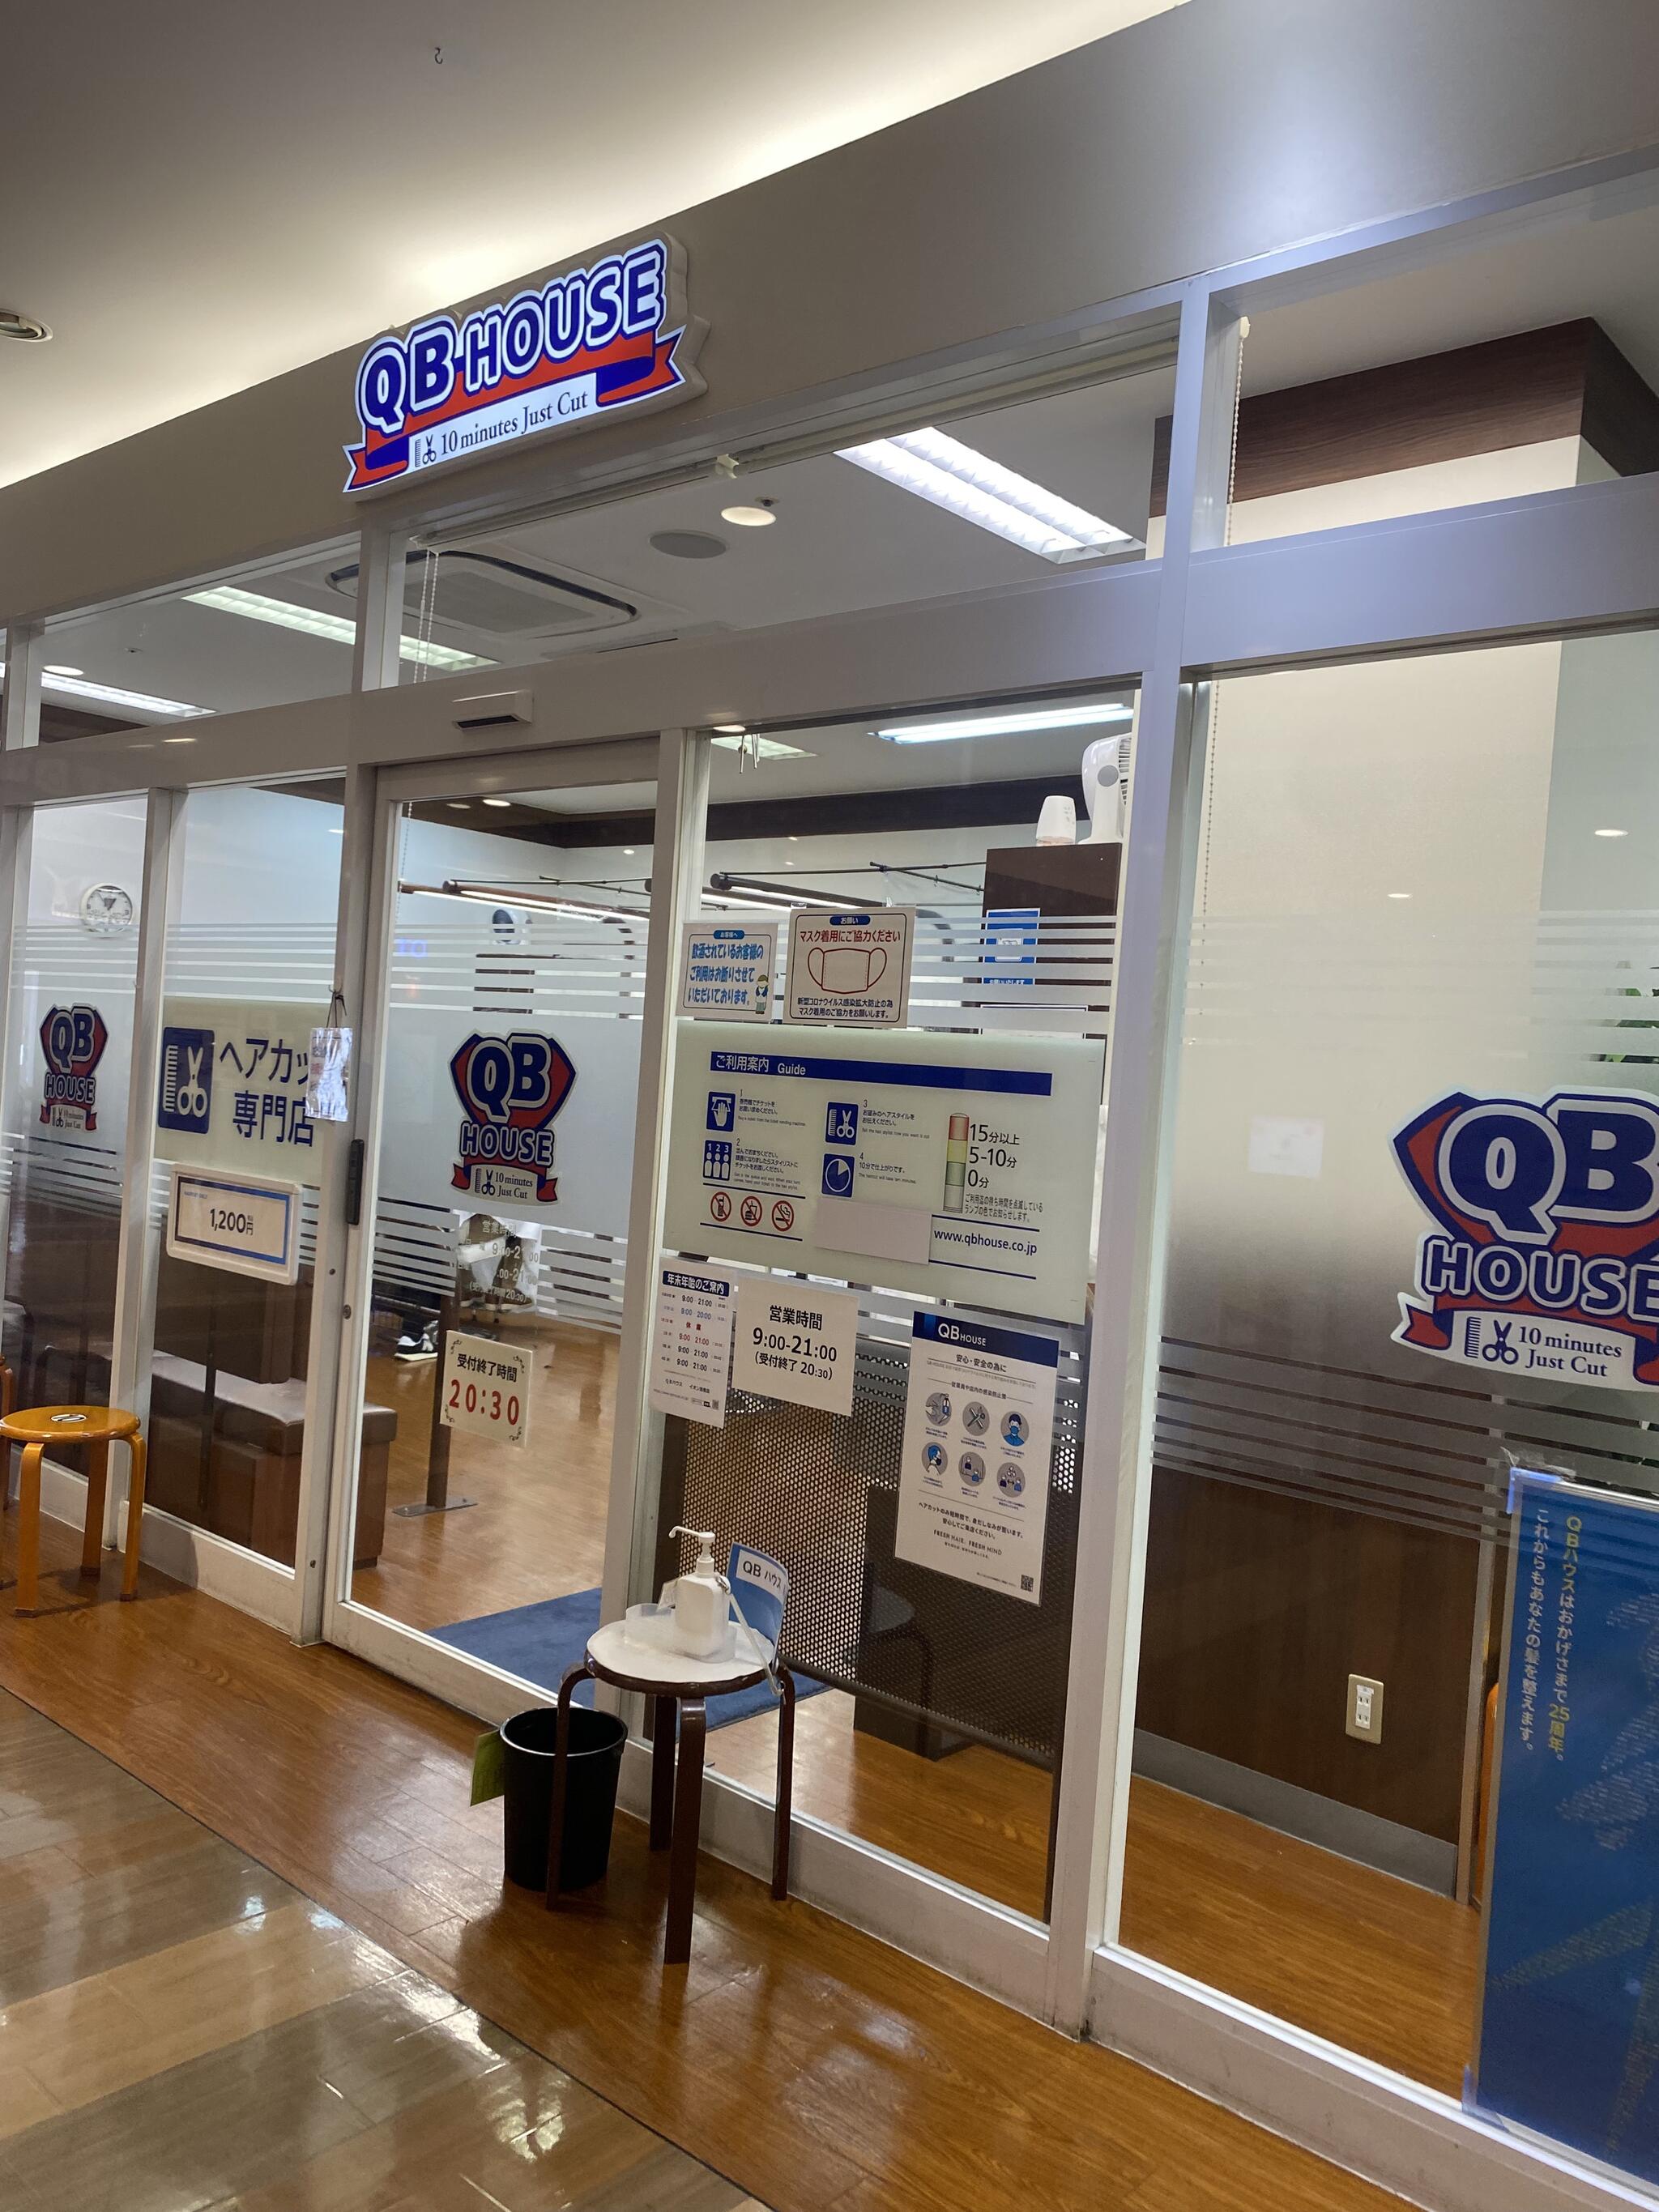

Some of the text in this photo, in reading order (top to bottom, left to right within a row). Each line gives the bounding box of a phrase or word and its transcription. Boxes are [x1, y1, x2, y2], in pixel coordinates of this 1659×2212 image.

[363, 249, 659, 428] QB HOUSE
[441, 391, 588, 456] 10 minutes Just Cut
[840, 916, 859, 925] お願い
[800, 929, 901, 943] マスク着用にご協力ください
[692, 943, 764, 961] 飲酒されているお客様の
[689, 965, 755, 982] ご利用はお断りさせて
[688, 987, 750, 1005] いただいております。
[799, 1008, 889, 1019] マスク着用のご協力をお願いします。
[49, 1009, 94, 1072] QB
[220, 1038, 311, 1085] ヘアカッ
[715, 1055, 806, 1076] ご利用案内 Guide
[45, 1074, 96, 1103] HOUSE
[468, 1040, 550, 1119] QB
[863, 1099, 868, 1108] 3
[232, 1089, 315, 1148] 専門店
[461, 1123, 554, 1166] HOUSE
[736, 1138, 740, 1147] 2
[970, 1123, 1020, 1145] 15分以上
[707, 1143, 729, 1153] 1 2 3
[859, 1152, 864, 1161] 4
[969, 1146, 1017, 1168] 5-10分
[495, 1171, 533, 1187] 10 minutes
[967, 1169, 989, 1188] 0分
[1447, 1107, 1657, 1237] QB
[497, 1184, 527, 1200] Just Cut
[934, 1230, 1037, 1256] www.qbhouse.co.jp
[667, 1273, 725, 1295] 年末年始のご案内
[1427, 1239, 1659, 1321] HOUSE
[681, 1294, 693, 1303] 9:00
[697, 1298, 712, 1307] 21:00
[770, 1305, 822, 1331] 営業時間
[753, 1327, 837, 1362] 9:00-21:00
[1517, 1325, 1622, 1358] 10 minutes
[457, 1353, 518, 1383] 受付終了時間
[956, 1354, 1007, 1372] 安心・安全の為に
[1525, 1349, 1608, 1379] Just Cut
[449, 1379, 519, 1426] 20:30
[933, 1529, 950, 1539] FRESH
[969, 1540, 986, 1551] FRESH
[987, 1545, 1003, 1556] MIND
[743, 1560, 761, 1578] QB
